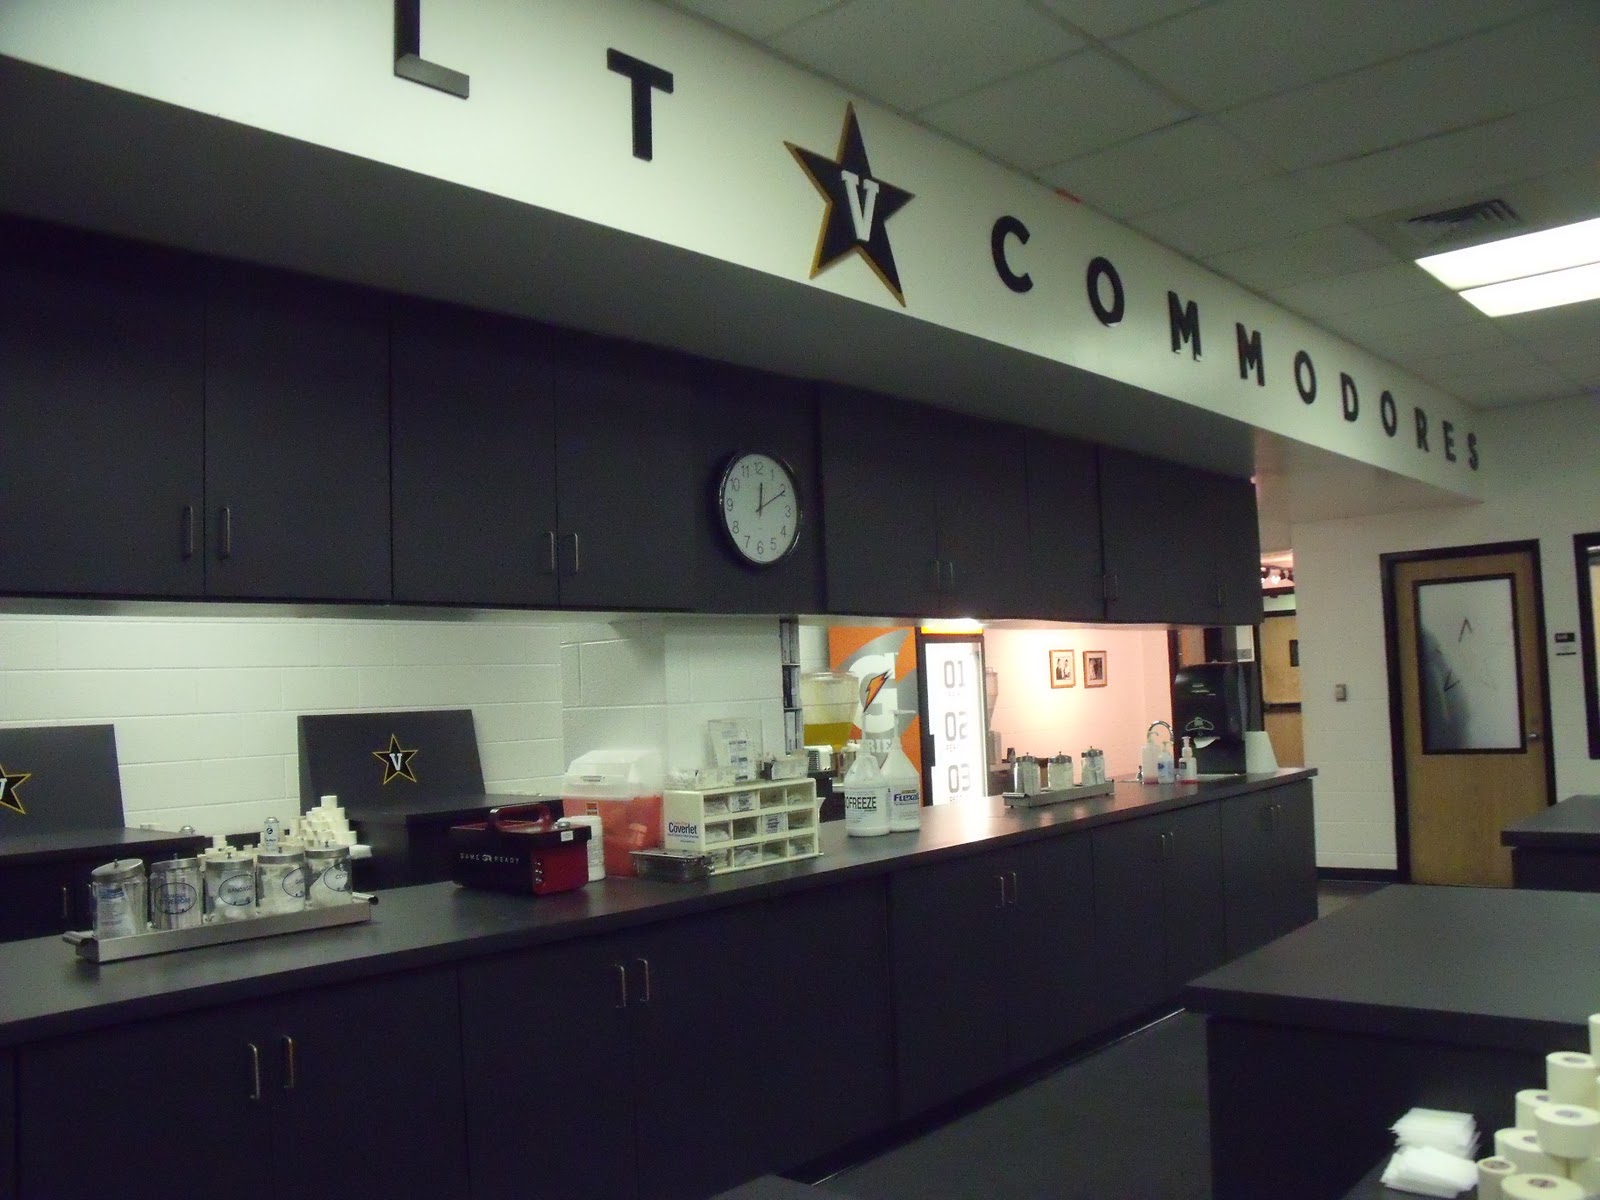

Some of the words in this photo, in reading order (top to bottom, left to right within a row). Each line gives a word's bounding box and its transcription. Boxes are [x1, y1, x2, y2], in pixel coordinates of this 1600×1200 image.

[991, 215, 1481, 471] COMMODORES
[741, 465, 749, 478] 11
[754, 462, 764, 475] 12
[731, 478, 740, 491] 10
[780, 483, 786, 497] 2
[727, 498, 733, 511] 9
[785, 505, 791, 518] 3
[732, 521, 739, 534] 8
[780, 525, 786, 538] 4
[744, 535, 750, 548] 7
[757, 541, 763, 554] 6
[771, 538, 777, 550] 5
[944, 660, 964, 688] 01
[945, 711, 968, 741] 02
[948, 764, 971, 793] 03
[668, 822, 697, 834] Coverlet
